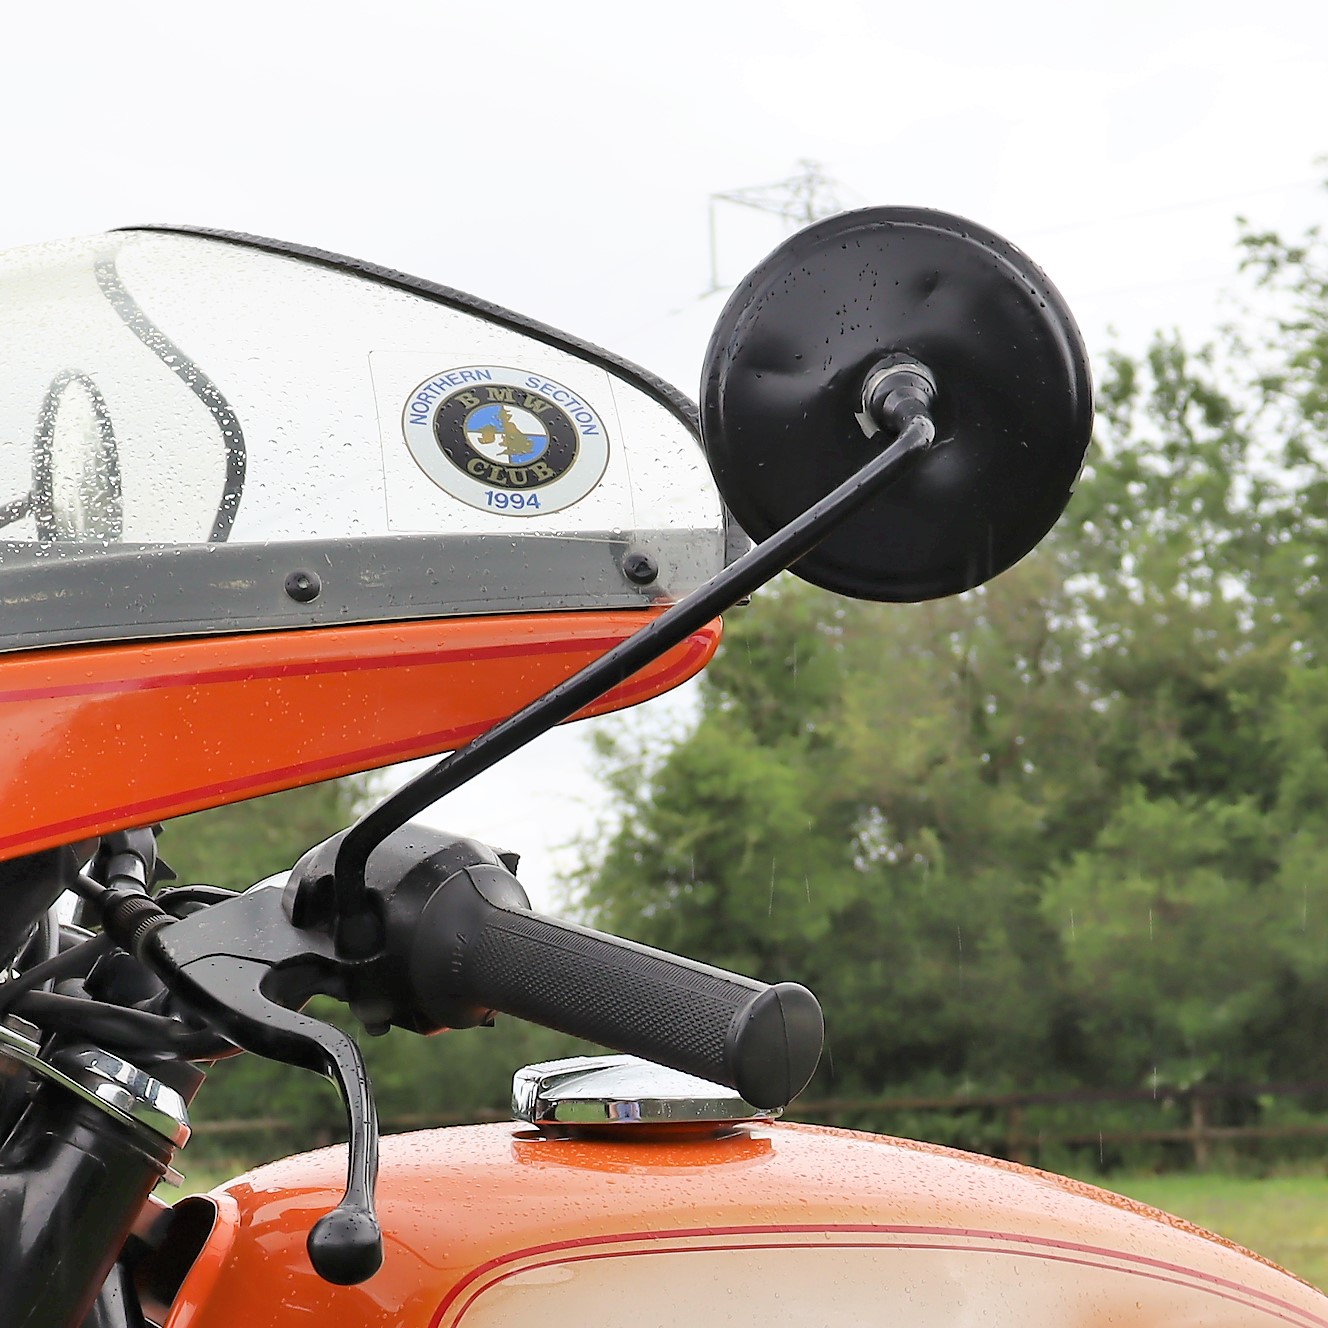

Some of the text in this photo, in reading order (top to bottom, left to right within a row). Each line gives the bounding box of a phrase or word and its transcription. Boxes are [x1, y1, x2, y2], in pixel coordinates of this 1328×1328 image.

[409, 369, 600, 436] NORTHERN SECTION
[454, 386, 554, 415] BMW
[467, 457, 556, 486] CLUB
[484, 490, 542, 510] 1994
